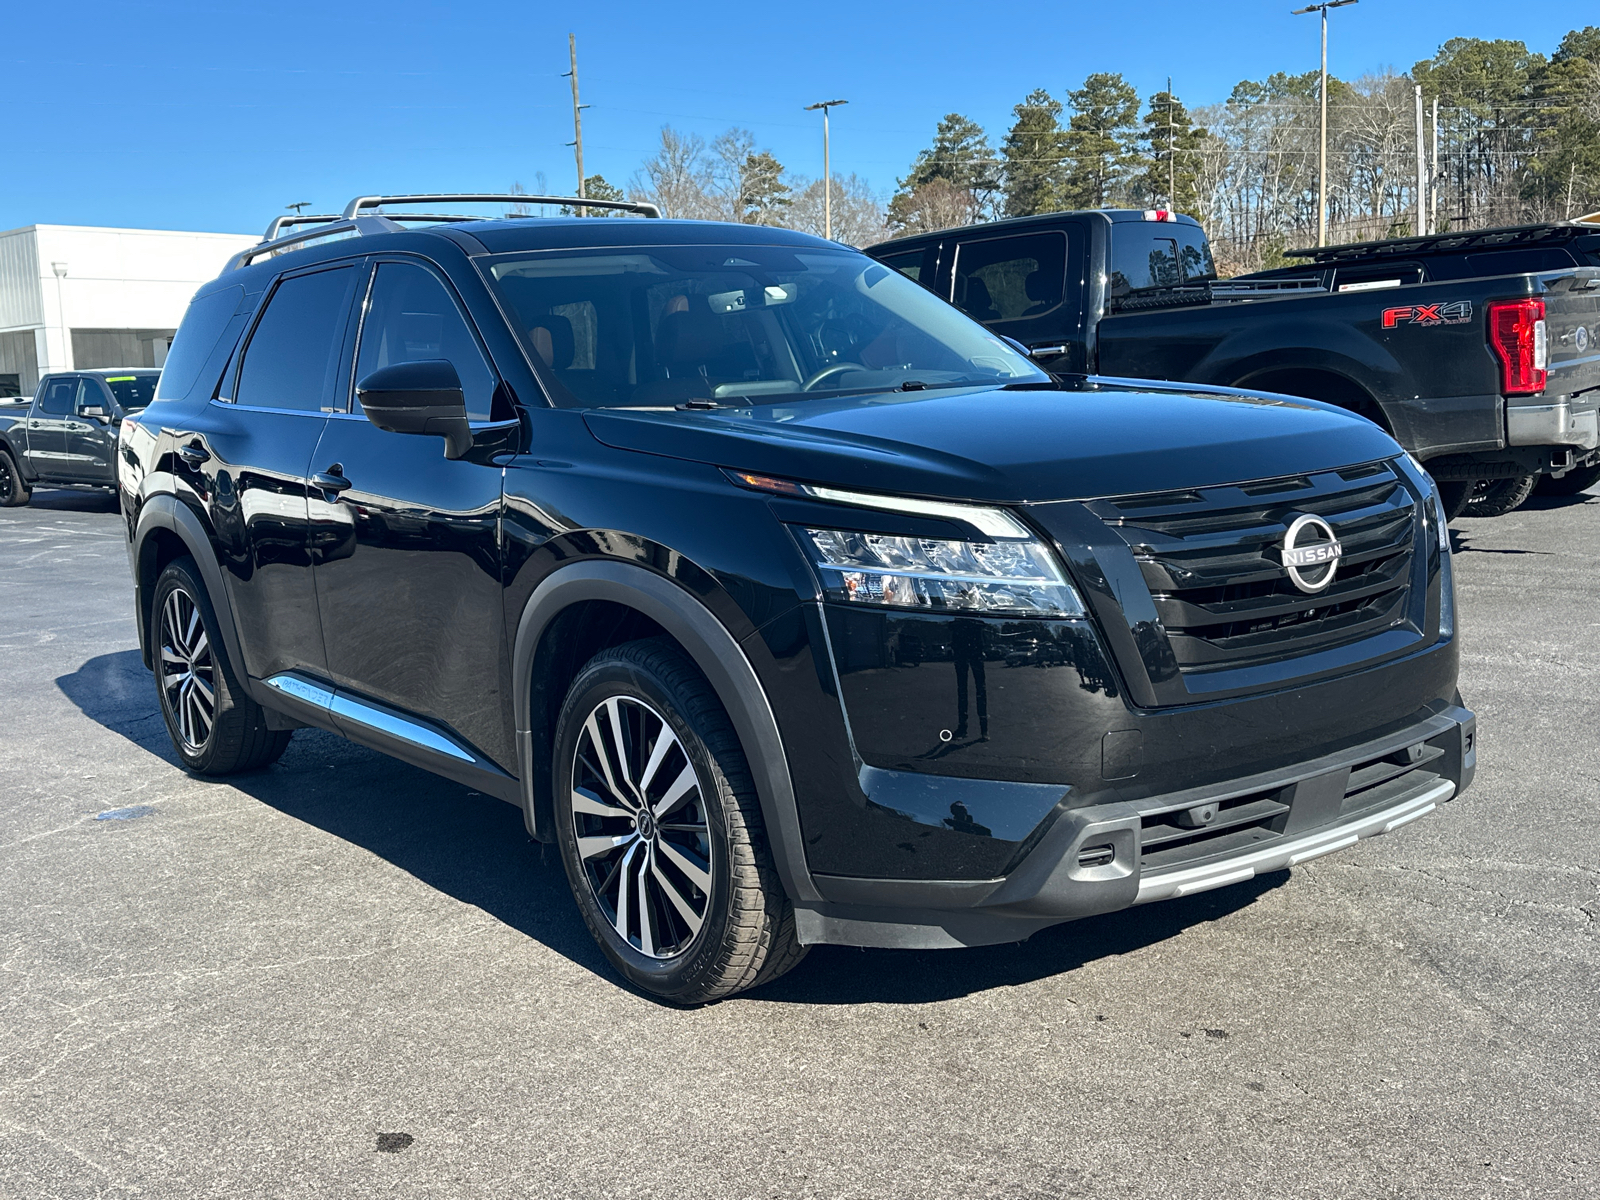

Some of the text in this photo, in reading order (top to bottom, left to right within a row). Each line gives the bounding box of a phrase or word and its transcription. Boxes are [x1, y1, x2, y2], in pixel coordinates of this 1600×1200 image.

[1381, 300, 1472, 329] FX4
[1284, 543, 1342, 565] NISSAN
[662, 700, 705, 767] KELLY
